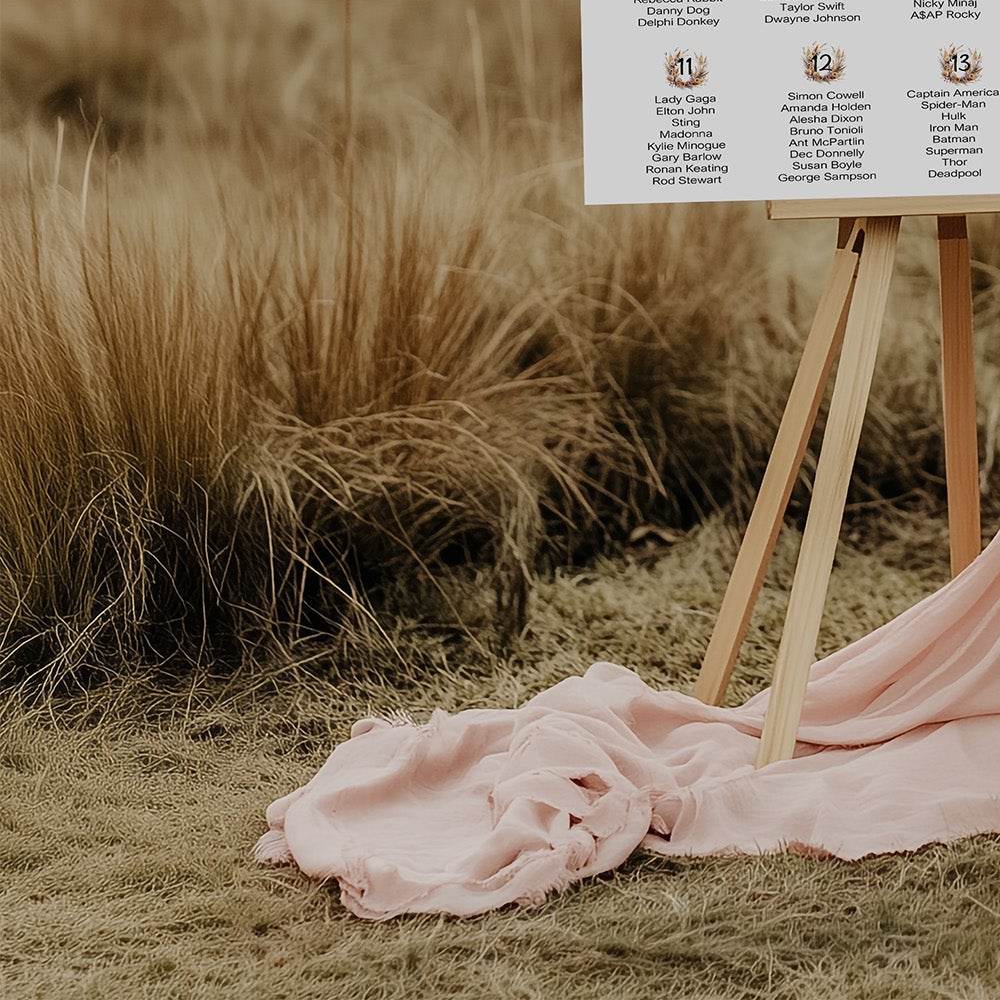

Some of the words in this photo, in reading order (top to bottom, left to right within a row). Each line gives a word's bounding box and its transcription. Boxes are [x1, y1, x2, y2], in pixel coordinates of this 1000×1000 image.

[677, 57, 693, 76] 11
[812, 54, 832, 72] 12
[950, 53, 970, 73] 13
[787, 91, 824, 101] Simon
[826, 90, 865, 100] Cowell
[906, 89, 951, 100] Captain
[952, 88, 1000, 98] America
[654, 95, 683, 106] Lady
[685, 94, 717, 105] Gaga
[920, 99, 986, 112] Spider-Man
[656, 106, 685, 116] Elton
[687, 106, 716, 115] John
[780, 103, 828, 113] Amanda
[831, 102, 872, 112] Holden
[789, 114, 828, 124] Alesha
[830, 113, 864, 124] Dixon
[941, 111, 967, 121] Hulk
[671, 117, 701, 129] Sting
[929, 123, 951, 133] Iron
[954, 123, 979, 132] Man
[659, 129, 713, 139] Madonna
[789, 126, 824, 136] Bruno
[826, 125, 864, 135] Tonioli
[932, 134, 976, 144] Batman
